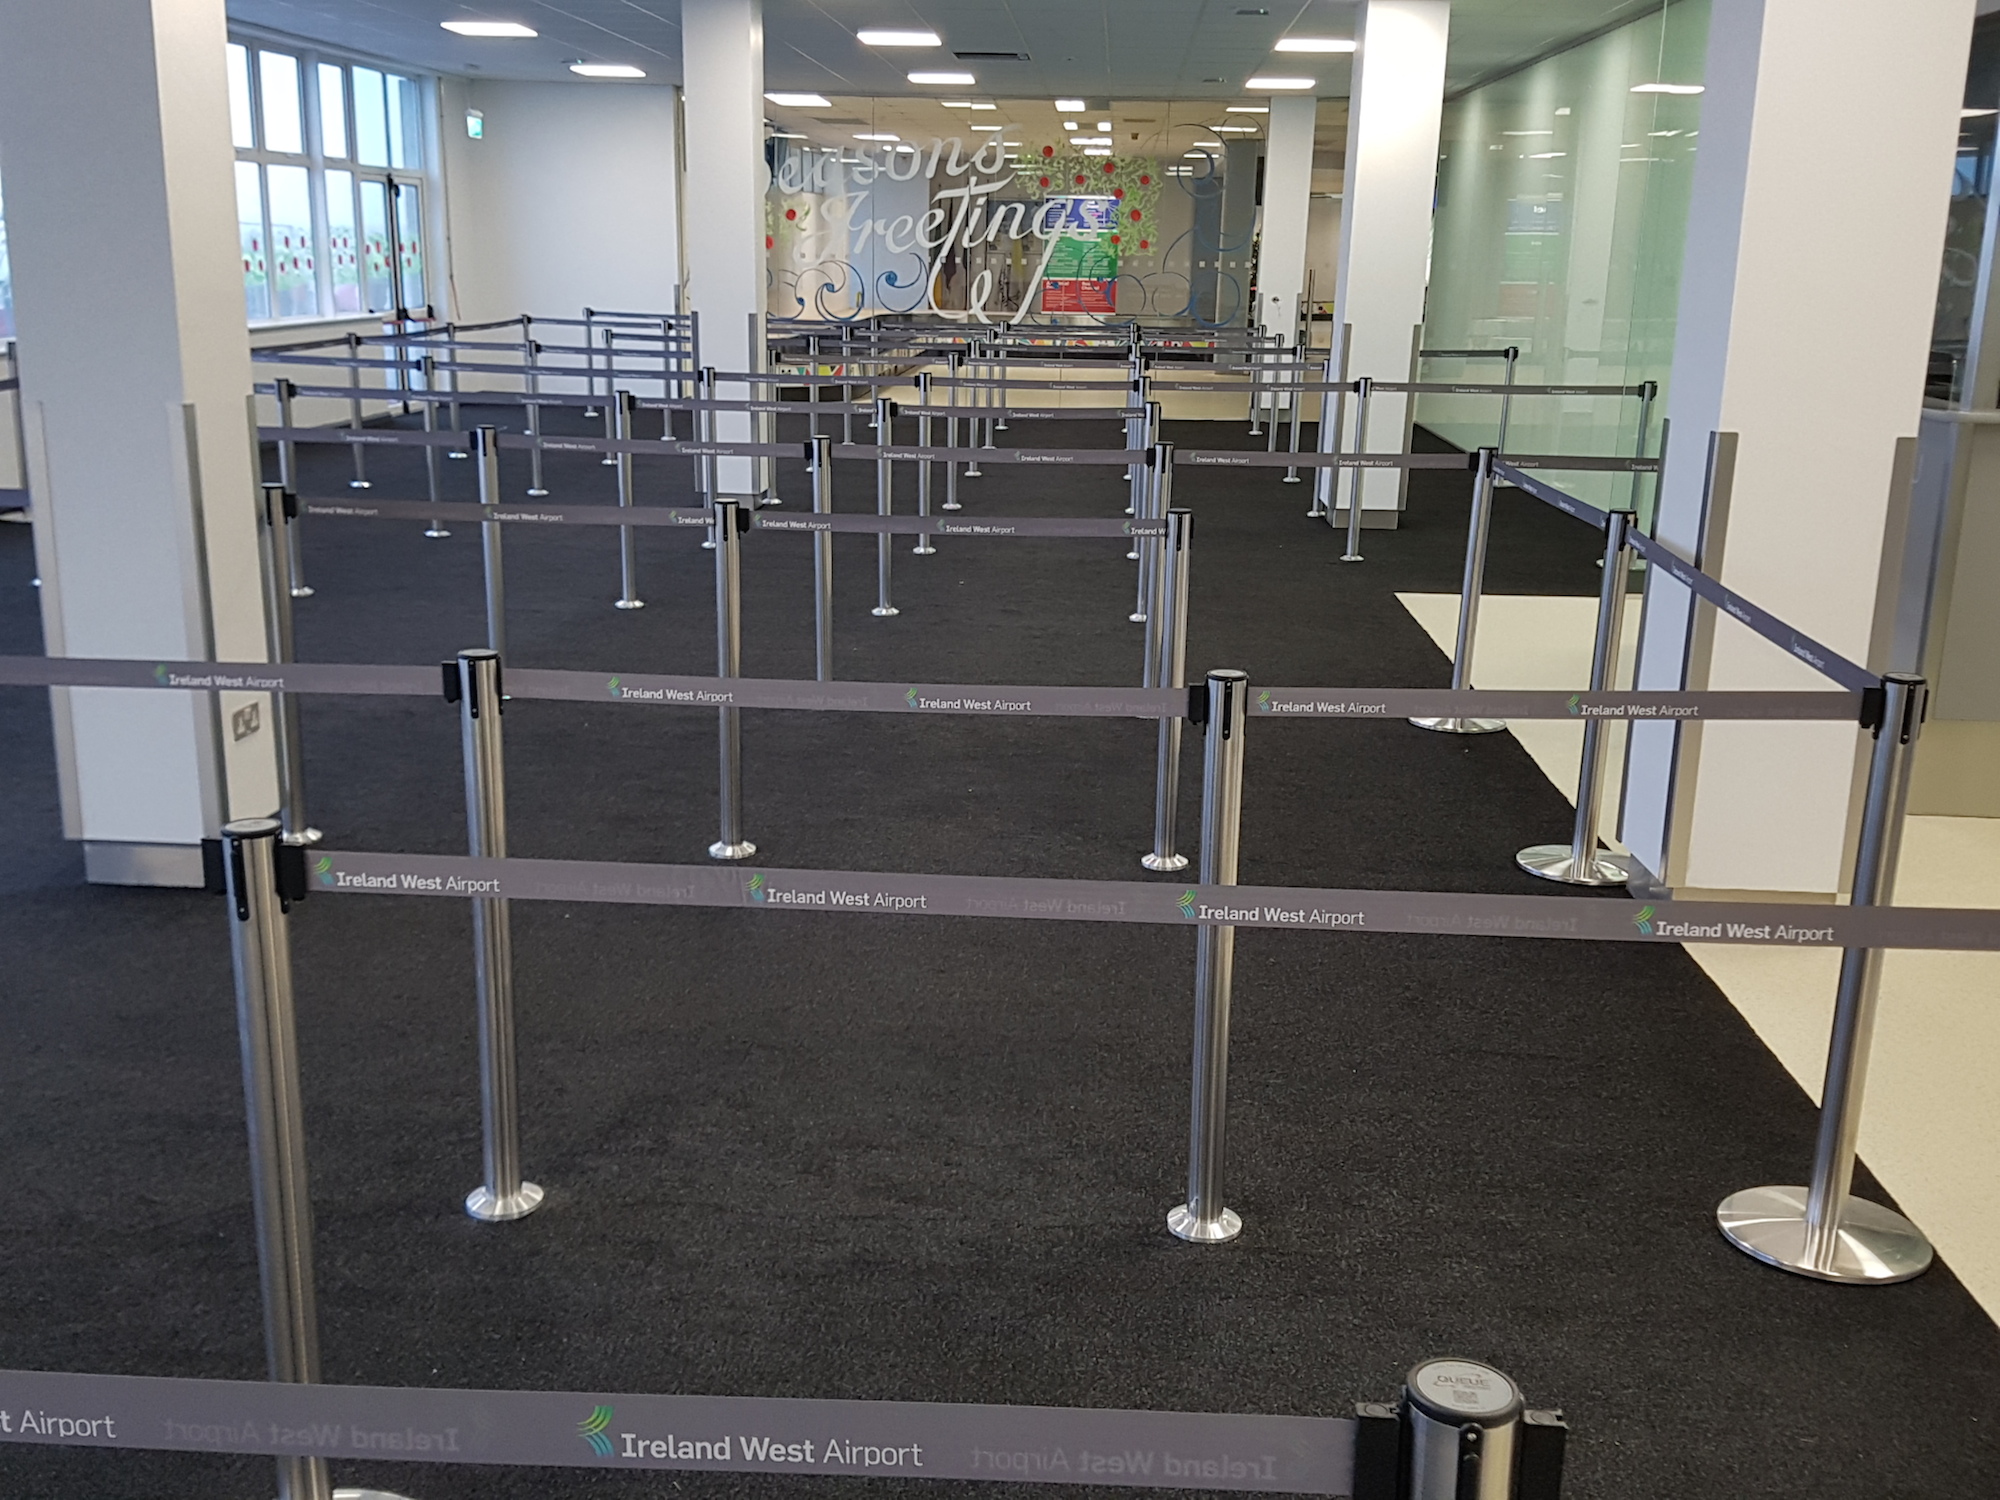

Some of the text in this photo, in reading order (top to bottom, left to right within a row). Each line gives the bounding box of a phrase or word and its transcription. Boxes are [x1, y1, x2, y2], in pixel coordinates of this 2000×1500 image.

[494, 512, 563, 523] Ireland West Airport
[678, 516, 704, 524] Ireland
[762, 520, 831, 530] Ireland West Airport
[946, 524, 1015, 534] Ireland West Airport
[1131, 527, 1158, 535] Ireland
[168, 673, 284, 690] Ireland West Airport
[622, 686, 734, 703] Ireland West Airport
[919, 696, 1032, 712] Ireland West Airport
[1271, 700, 1386, 715] Ireland West Airport
[1580, 704, 1699, 717] Ireland West Airport
[336, 872, 500, 894] Ireland West Airport
[767, 888, 927, 911] Ireland West Airport
[1198, 904, 1366, 928] Ireland West Airport
[1656, 920, 1834, 943] Ireland West Airport
[1437, 1374, 1490, 1386] QUEUE
[20, 1410, 117, 1440] Airport
[620, 1432, 924, 1467] Ireland West Airport
